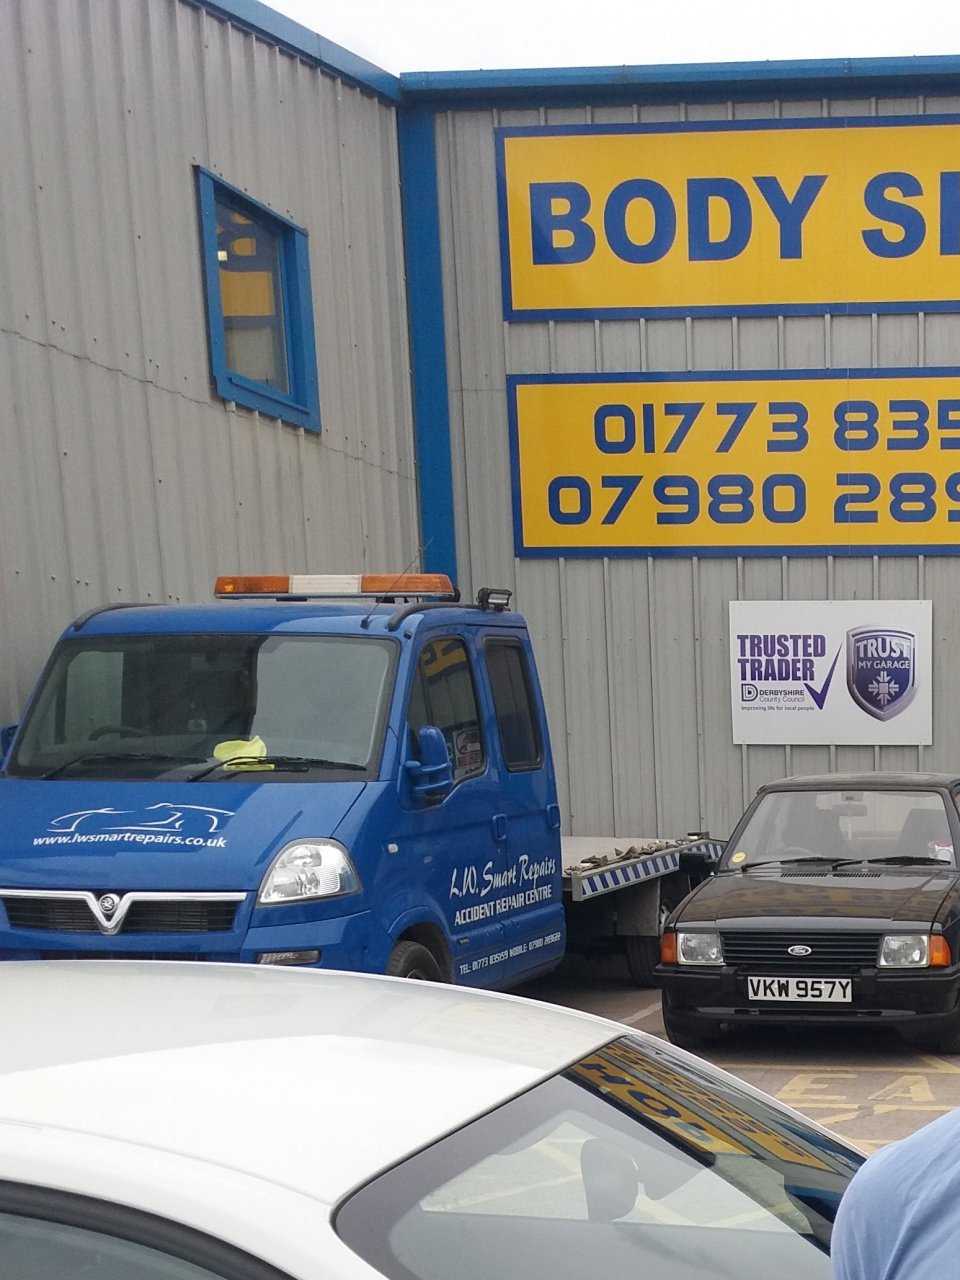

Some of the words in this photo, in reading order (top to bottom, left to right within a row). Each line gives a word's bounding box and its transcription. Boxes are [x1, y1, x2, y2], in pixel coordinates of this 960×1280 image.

[529, 175, 828, 265] BODY
[594, 402, 809, 454] 01773
[548, 473, 807, 526] 07980
[737, 634, 826, 658] TRUSTED
[856, 637, 911, 659] TRUST
[738, 658, 815, 681] TRADER
[858, 660, 873, 669] MY
[874, 660, 910, 669] GARAGE
[759, 695, 781, 703] County
[782, 695, 805, 703] Council
[33, 832, 228, 848] www.lwsmartrepairs.co.uk
[450, 865, 479, 899] L.W.
[480, 861, 517, 897] Smart
[518, 854, 556, 889] Repairs
[454, 901, 496, 926] ACCIDENT
[496, 892, 525, 914] REPAIR
[525, 884, 552, 905] CENTRE
[750, 979, 790, 998] VKW
[795, 980, 850, 999] 957Y
